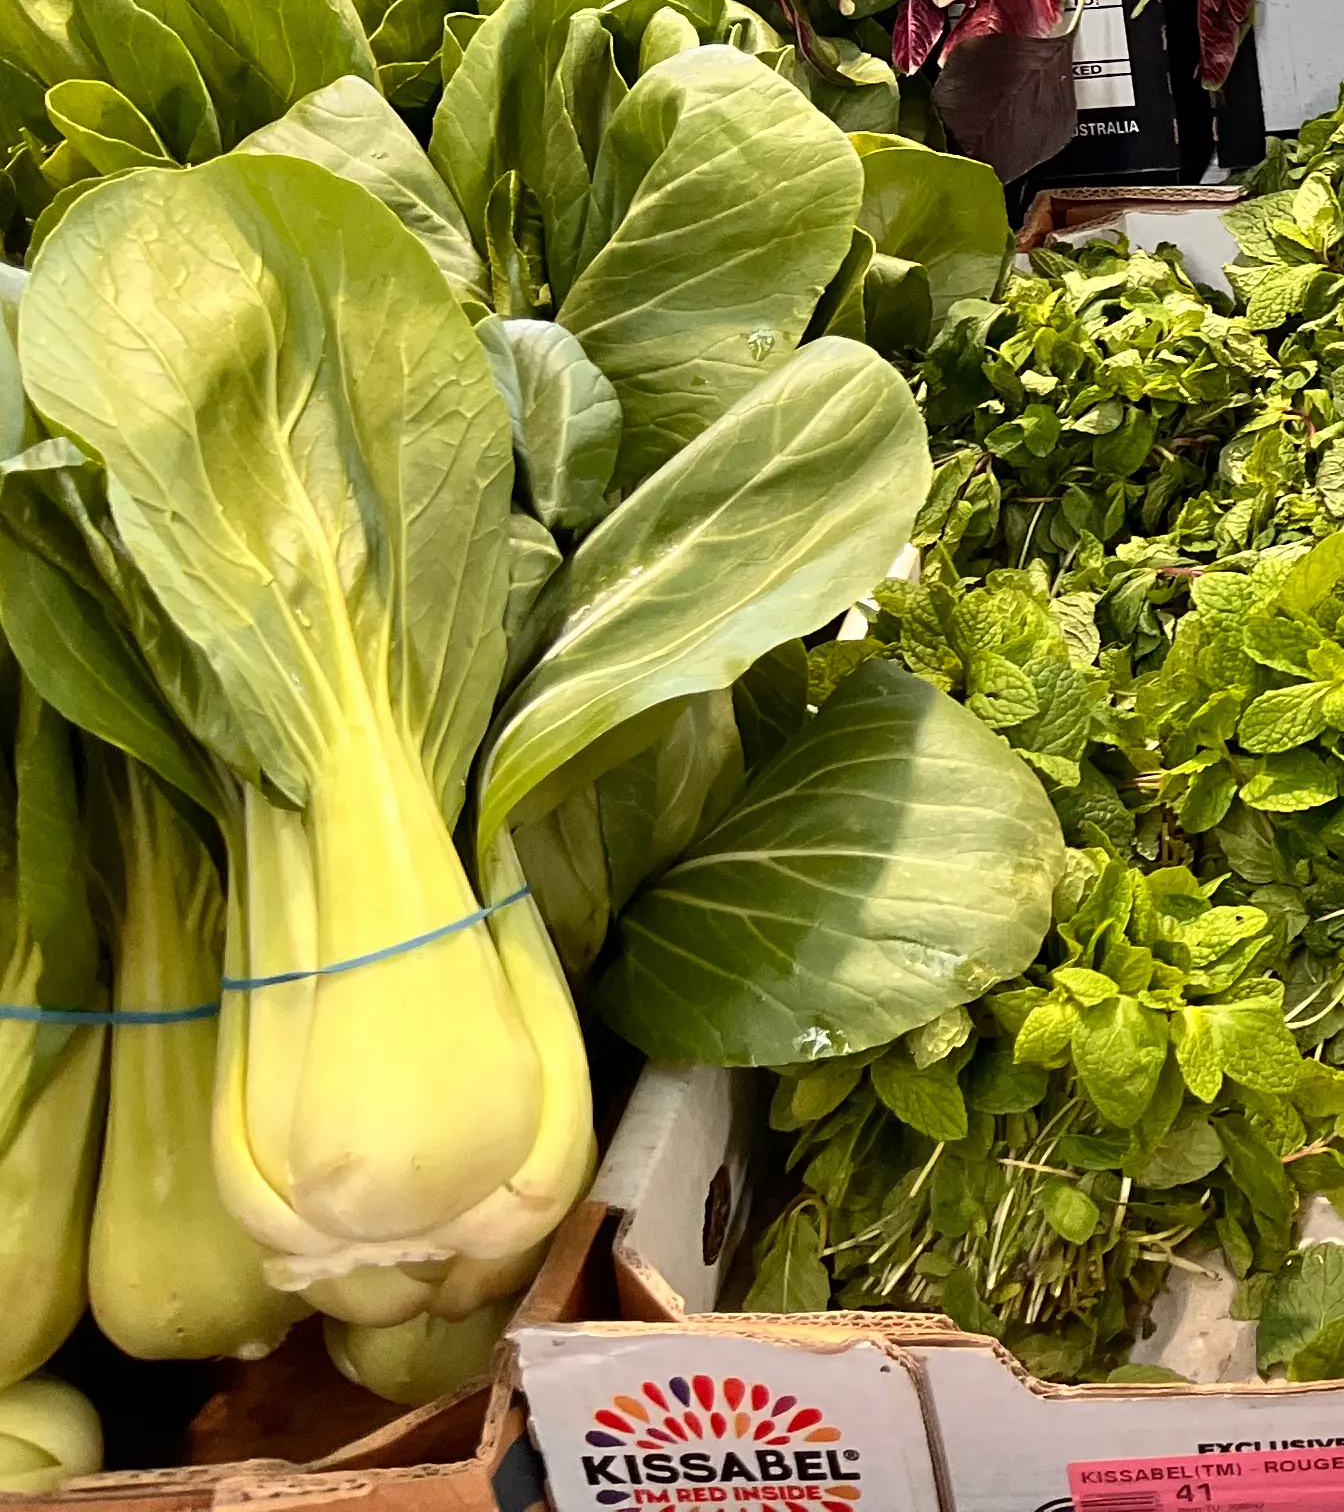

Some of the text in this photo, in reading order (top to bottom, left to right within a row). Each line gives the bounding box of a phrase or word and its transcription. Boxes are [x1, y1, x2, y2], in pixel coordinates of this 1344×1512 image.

[1081, 1462, 1242, 1484] KISSABEL(TM)
[1264, 1456, 1344, 1474] ROUGE
[634, 1485, 822, 1504] I'M RED INSIDE
[1175, 1483, 1212, 1502] 41
